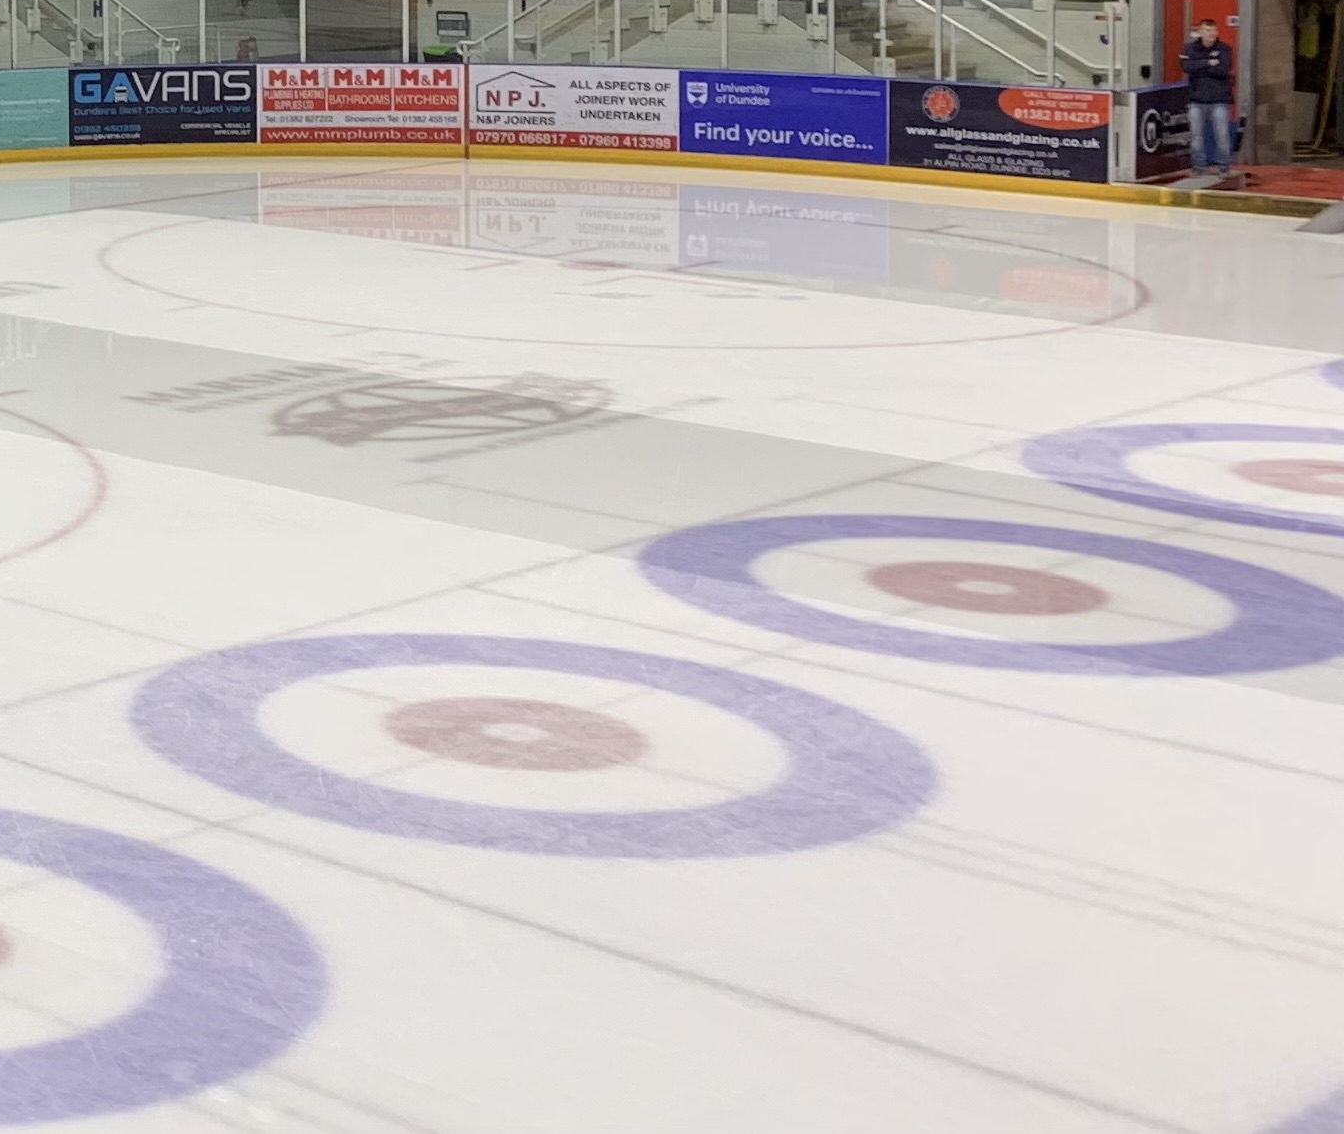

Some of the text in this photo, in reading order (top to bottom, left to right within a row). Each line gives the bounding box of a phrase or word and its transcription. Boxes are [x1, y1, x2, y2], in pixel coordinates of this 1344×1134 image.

[269, 69, 319, 87] M&M
[334, 69, 385, 87] M&M
[400, 69, 452, 87] M&M
[569, 80, 671, 92] ALL ASPECTS OF
[715, 82, 770, 96] University
[329, 94, 391, 105] BATHROOMS
[395, 94, 458, 105] KITCHENS
[575, 95, 666, 106] JOINERY WORK
[715, 95, 770, 106] of Dundee
[580, 110, 661, 121] UNDERTAKEN
[1014, 108, 1051, 120] 01382
[477, 116, 555, 126] N&P JOINERS
[267, 129, 455, 141] www.mmplumb.co.uk
[476, 131, 515, 143] 07970
[579, 135, 619, 147] 07960
[694, 122, 874, 150] Find your voice...
[905, 125, 1100, 149] www.allglassandglazing.co.uk
